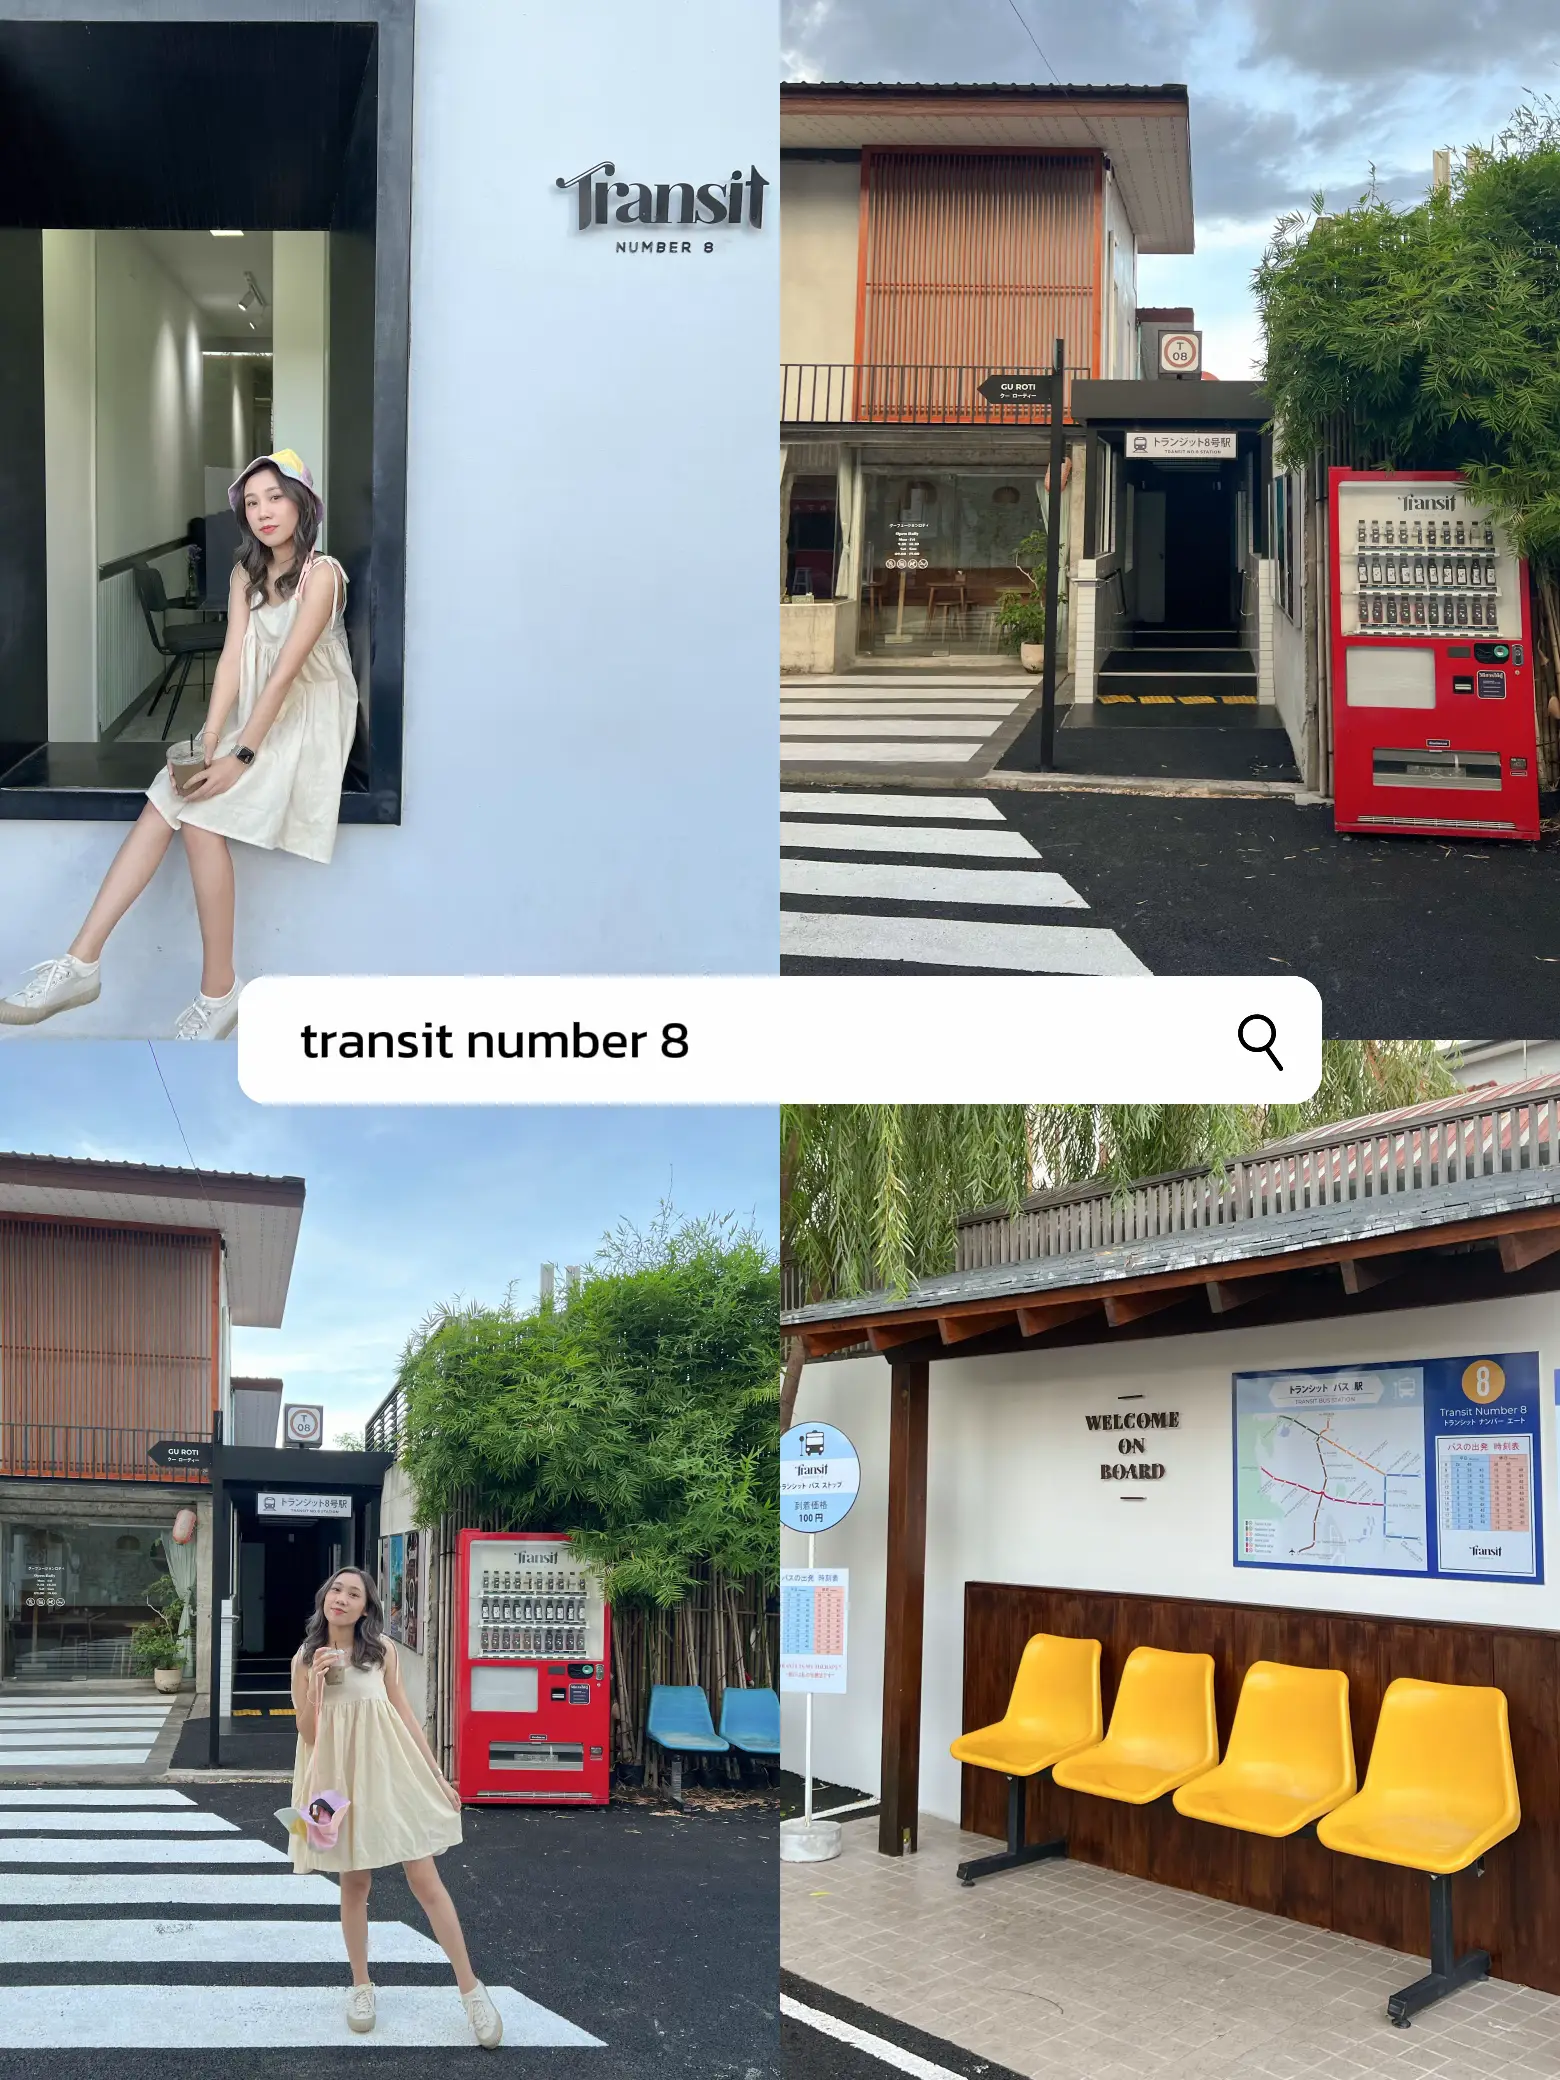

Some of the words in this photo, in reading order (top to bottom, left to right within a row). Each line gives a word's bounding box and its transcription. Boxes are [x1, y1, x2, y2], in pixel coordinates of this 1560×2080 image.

[556, 161, 770, 230] Transit
[615, 241, 691, 253] NUMBER
[703, 241, 714, 253] 8
[1176, 341, 1185, 350] T
[1172, 352, 1188, 361] 08
[1000, 383, 1014, 391] GU
[1015, 383, 1036, 391] ROTI
[1154, 436, 1231, 448] トランジット8号駅
[1397, 493, 1457, 511] Transit
[1333, 1382, 1349, 1391] バス
[1354, 1381, 1363, 1391] 駅
[1476, 1366, 1490, 1397] 8
[1440, 1407, 1472, 1417] Transit
[1475, 1405, 1518, 1416] Number
[1520, 1405, 1527, 1414] 8
[300, 1414, 308, 1422] T
[1085, 1411, 1180, 1431] WELCOME
[297, 1423, 311, 1432] 08
[1118, 1437, 1146, 1454] ON
[794, 1464, 828, 1476] Transit
[1100, 1463, 1166, 1480] BOARD
[281, 1497, 347, 1509] トランジット8号駅
[1469, 1544, 1502, 1557] Transit
[513, 1550, 558, 1564] Transit
